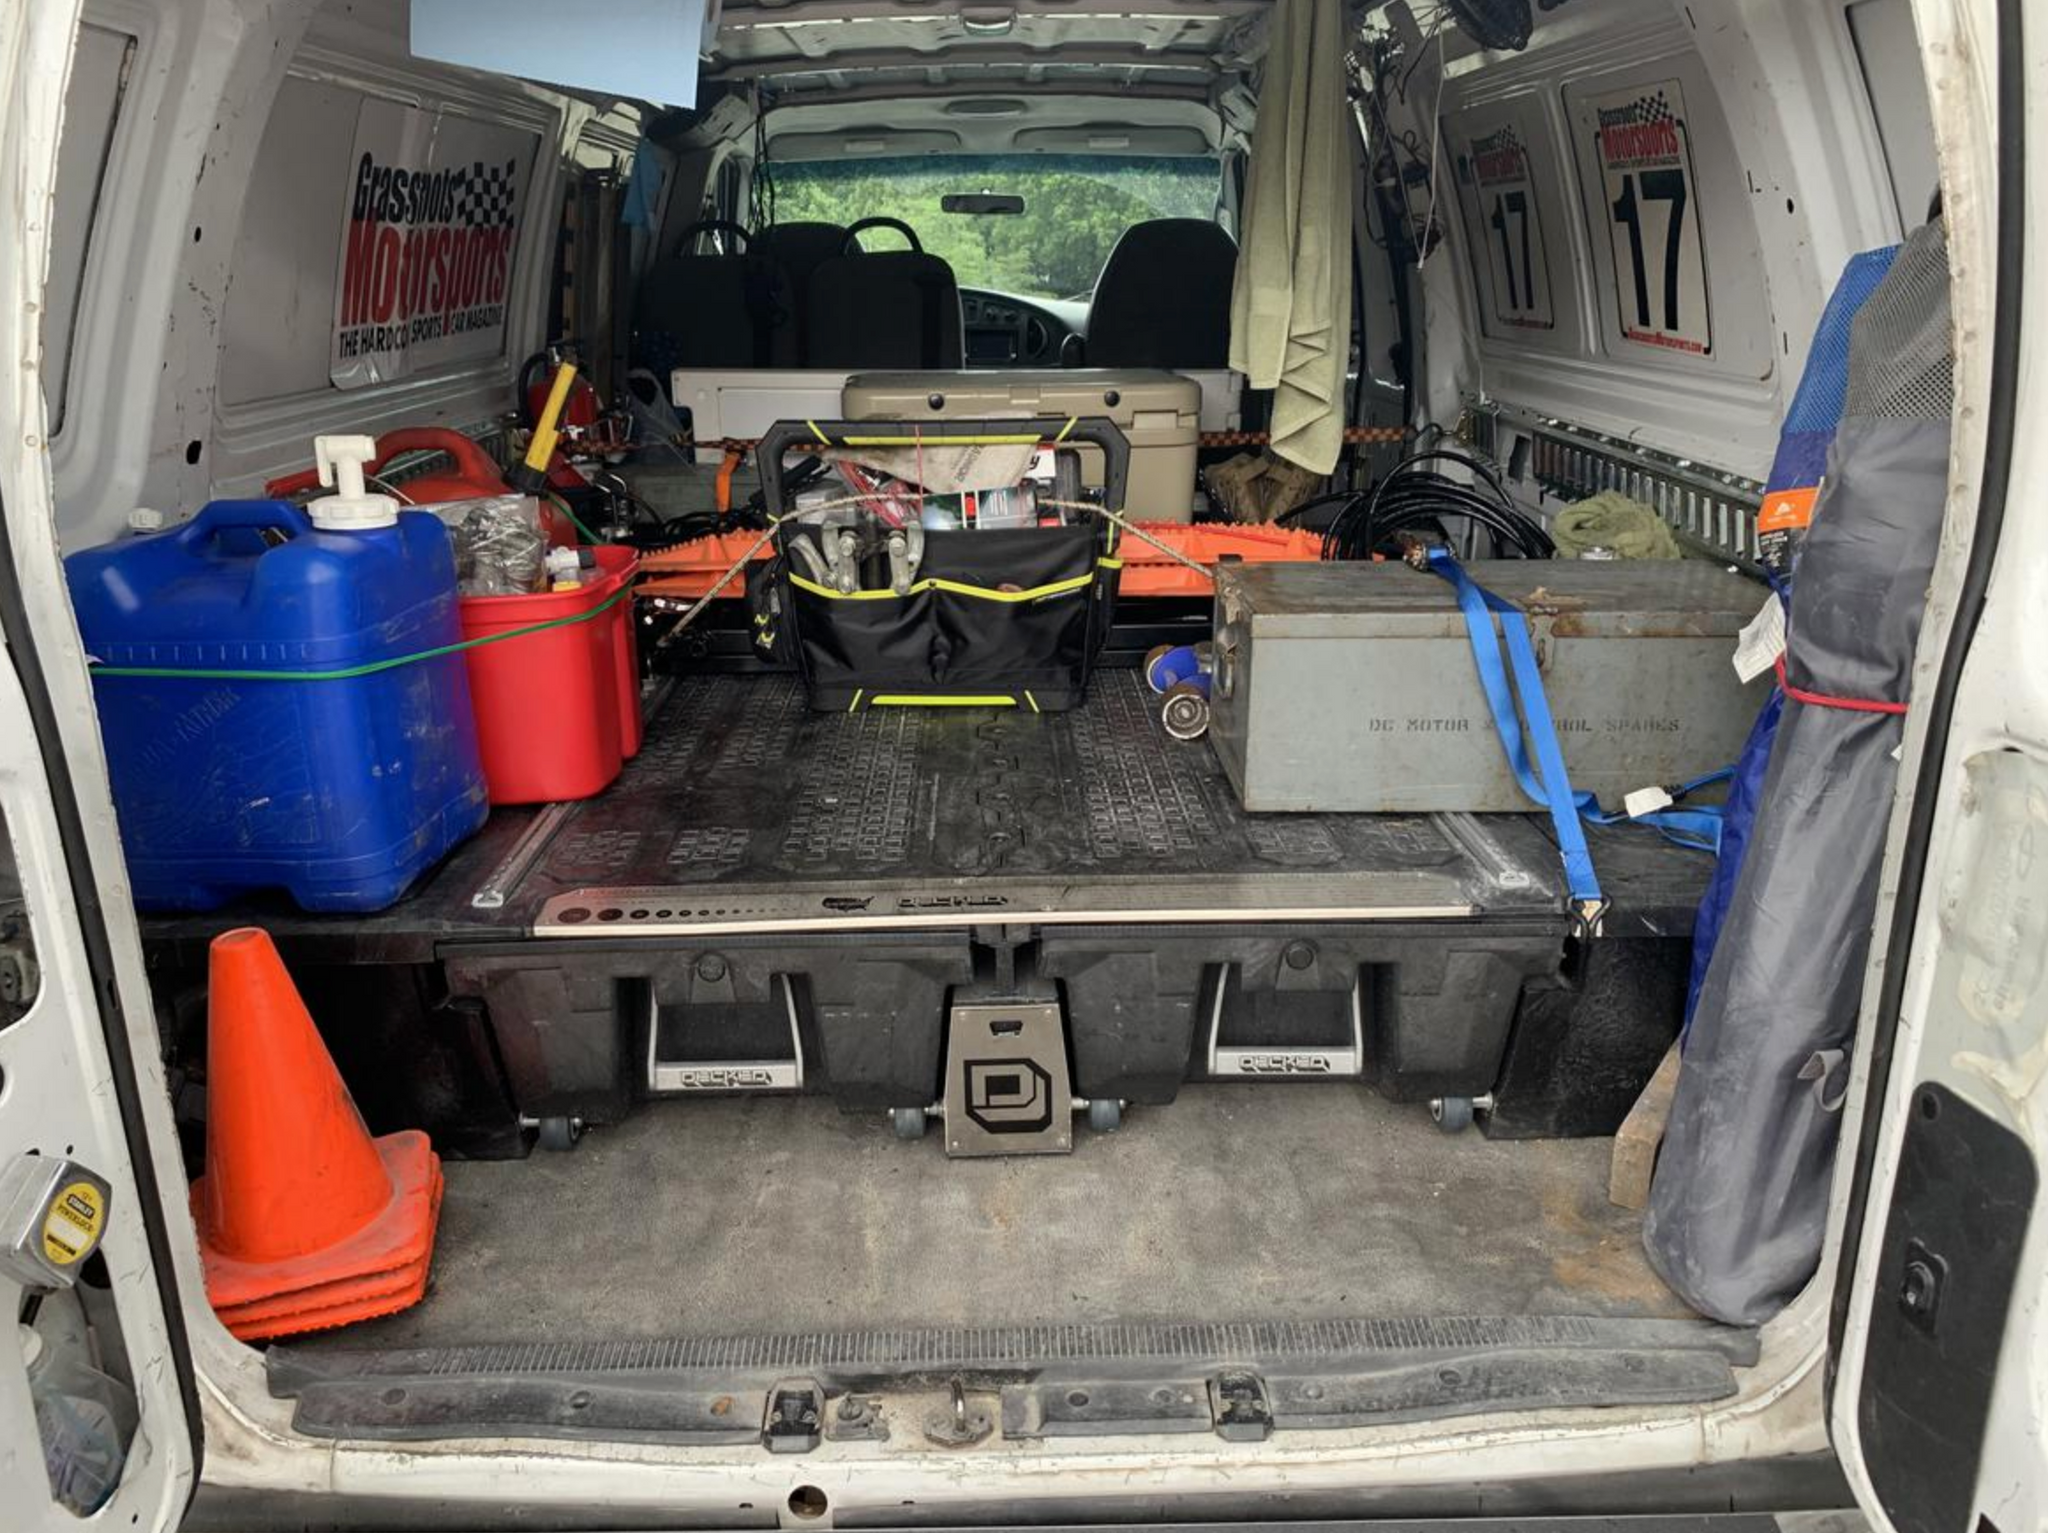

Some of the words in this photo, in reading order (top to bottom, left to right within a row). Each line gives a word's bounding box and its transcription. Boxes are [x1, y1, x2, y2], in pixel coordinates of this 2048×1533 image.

[1491, 190, 1533, 310] 17
[1613, 169, 1686, 330] 17
[340, 331, 358, 359] THE
[360, 324, 410, 354] HARDCO
[411, 315, 443, 343] SPORTS
[451, 311, 465, 334] CAR
[466, 304, 504, 331] MAGAZINE
[1369, 719, 1394, 732] DC
[1406, 719, 1469, 732] MOTOR
[1606, 719, 1680, 732] SPARES
[897, 895, 1008, 907] DECKED
[1239, 1055, 1331, 1073] DECKED
[681, 1069, 773, 1087] DECKED
